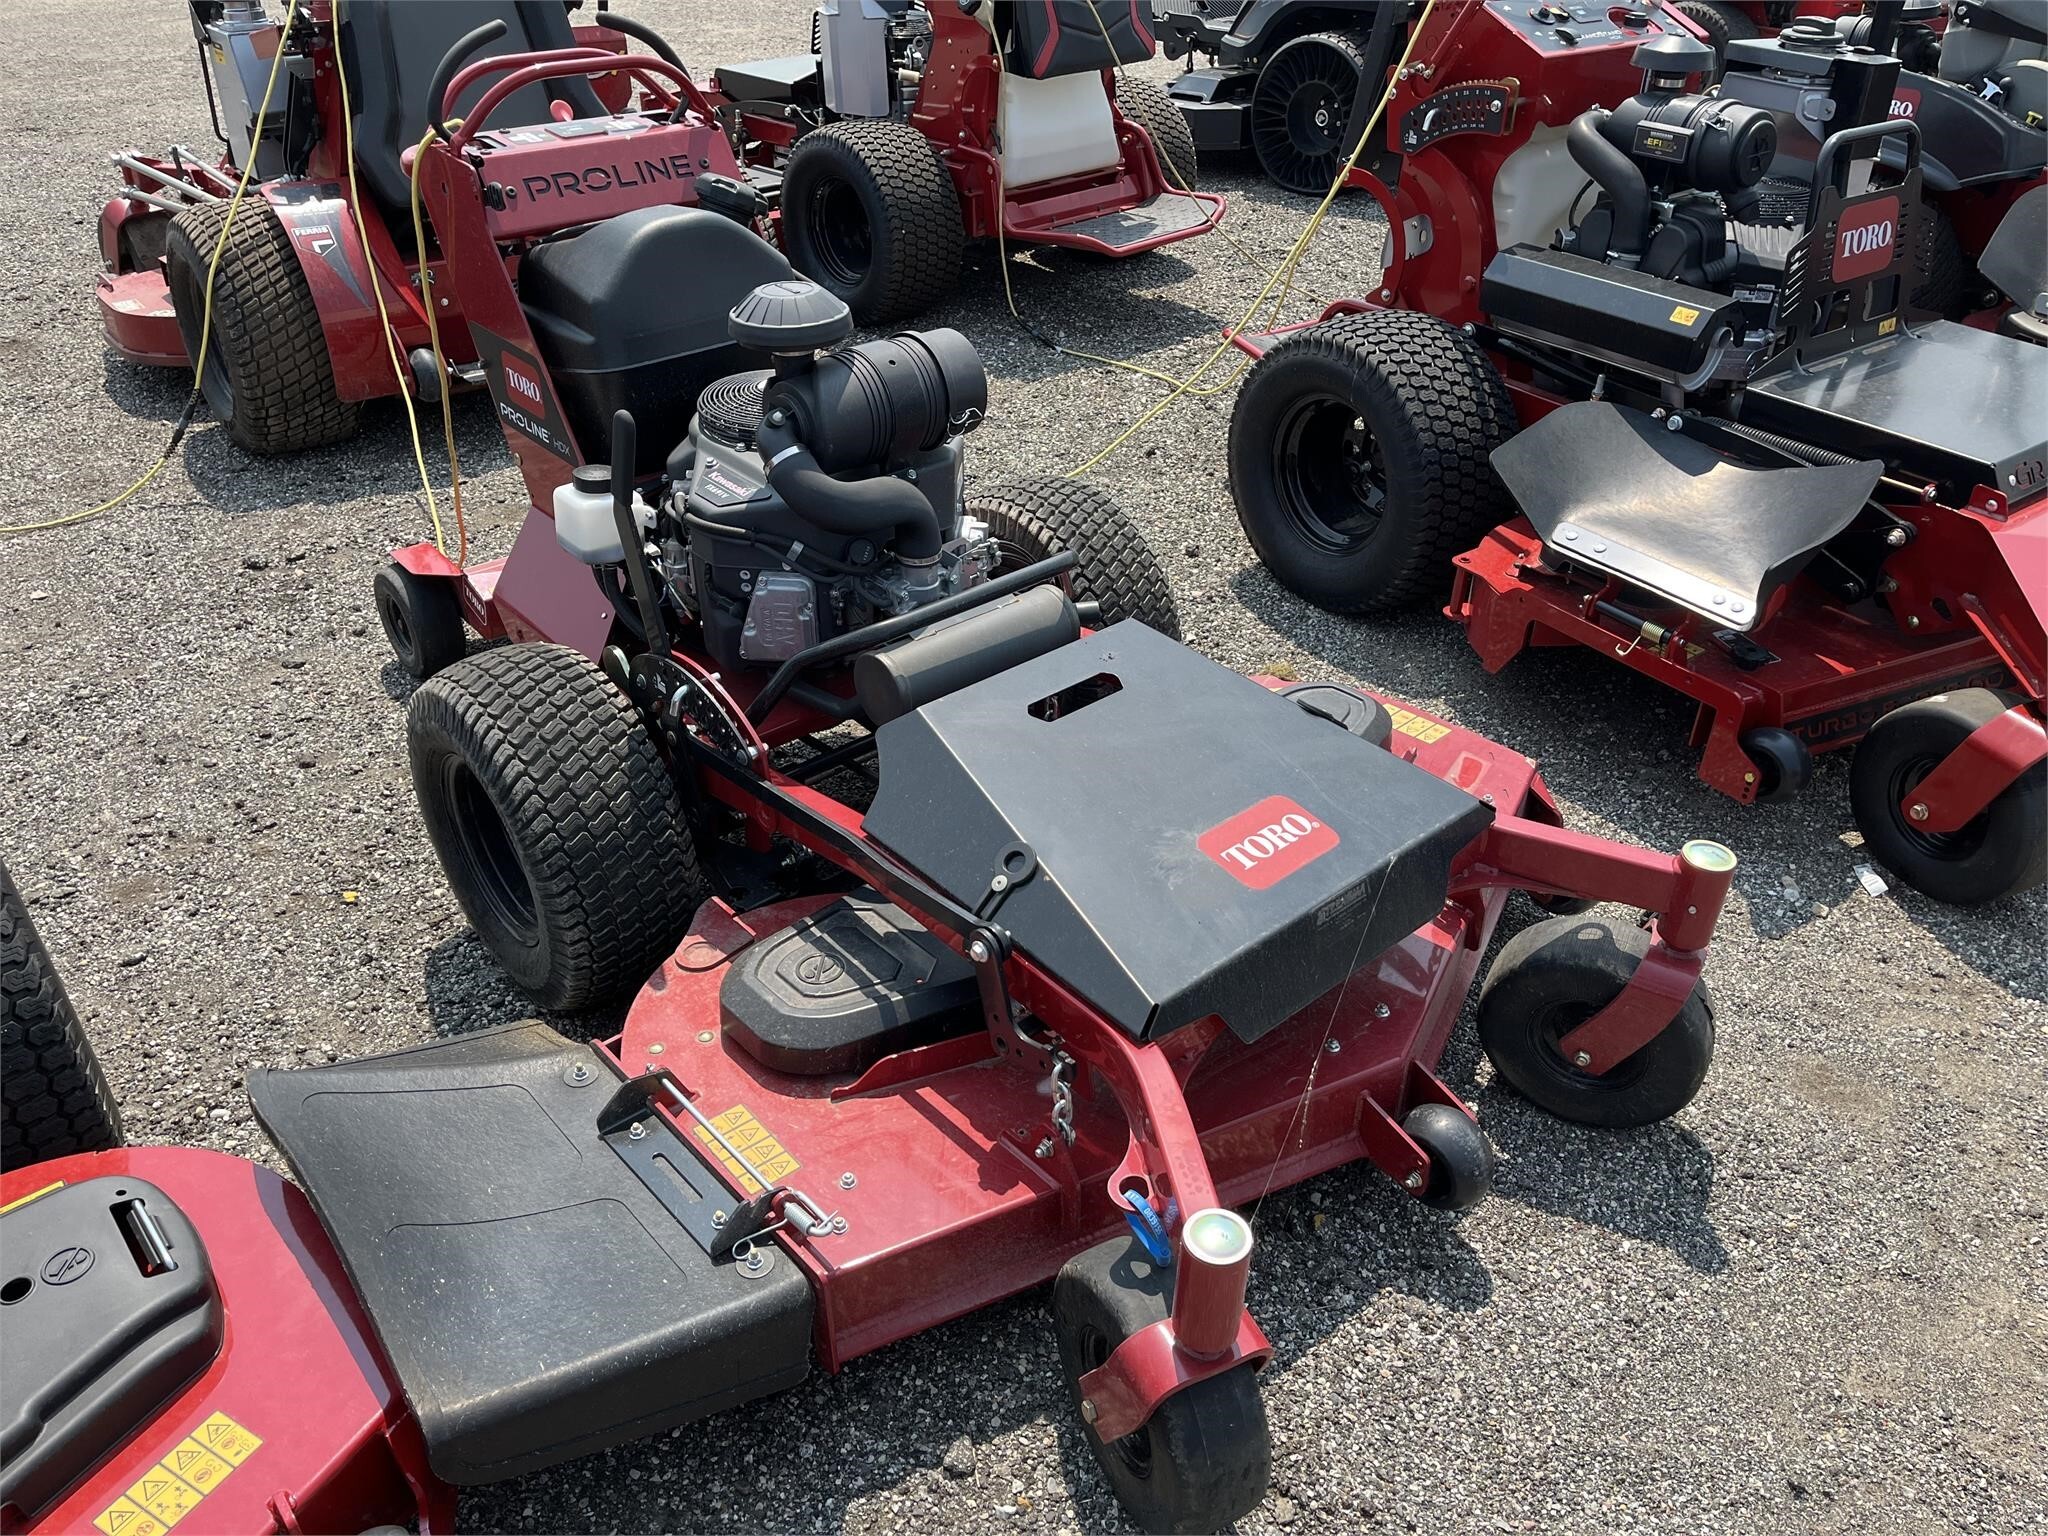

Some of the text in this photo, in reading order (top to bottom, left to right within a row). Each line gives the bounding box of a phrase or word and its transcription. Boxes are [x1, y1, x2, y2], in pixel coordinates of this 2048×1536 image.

[1889, 100, 1913, 117] RO
[1647, 137, 1663, 147] EFI
[521, 153, 695, 202] PROLINE
[1841, 220, 1893, 258] TORO
[505, 367, 541, 403] TORO
[500, 402, 571, 457] PROLINE HDX
[708, 471, 753, 497] Kawasaki
[1220, 813, 1314, 870] TORO
